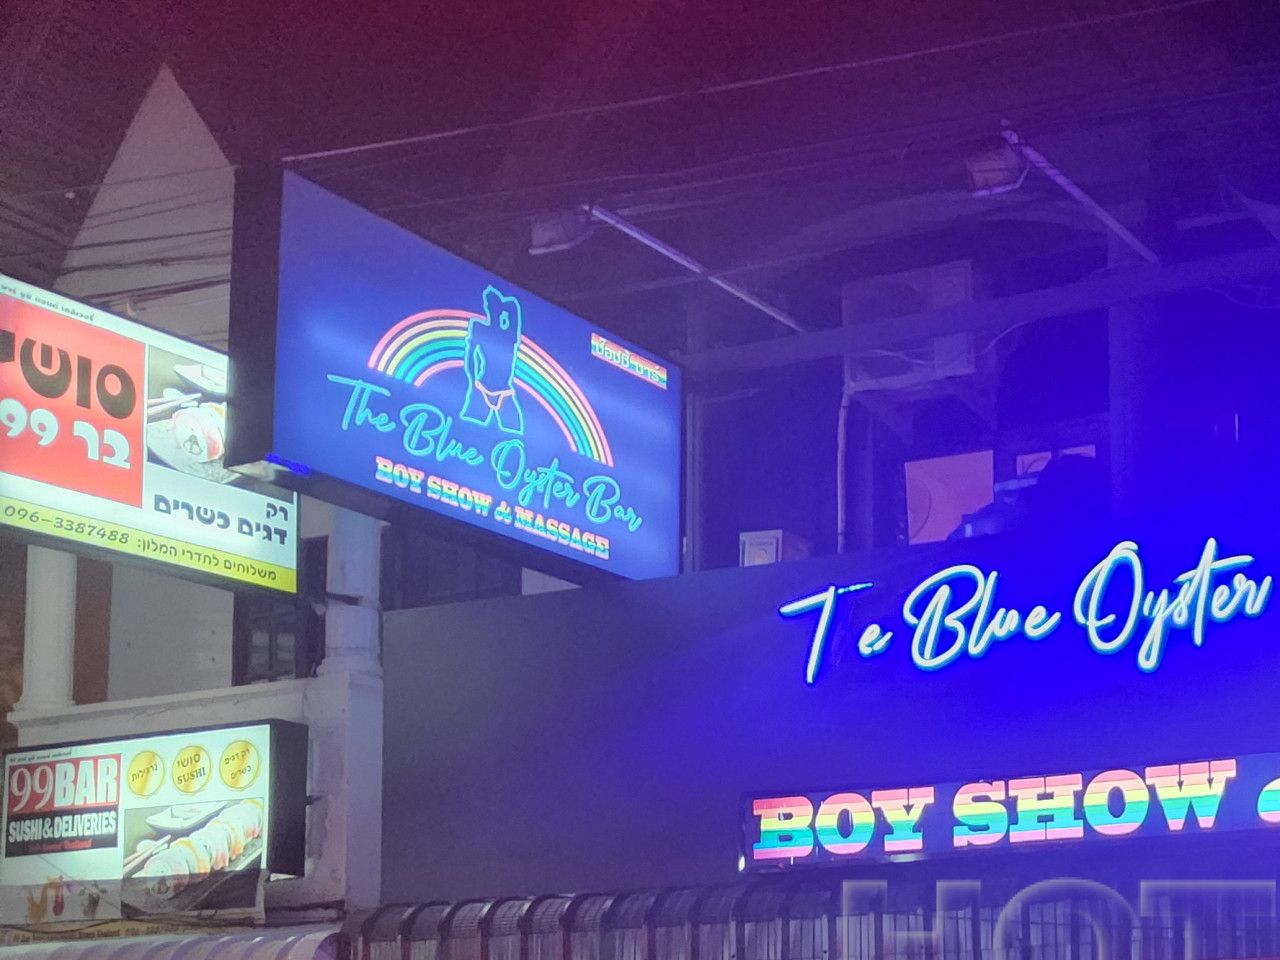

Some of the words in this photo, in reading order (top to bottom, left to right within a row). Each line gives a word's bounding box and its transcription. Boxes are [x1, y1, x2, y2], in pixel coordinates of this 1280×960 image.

[0, 399, 59, 446] 99
[73, 420, 131, 469] בר
[326, 374, 396, 431] The
[400, 403, 484, 466] Blue
[491, 439, 581, 509] Oyster
[583, 475, 643, 532] Bar
[4, 505, 130, 544] 096-3387488
[154, 495, 230, 530] כשרים
[266, 502, 289, 522] רק
[375, 456, 425, 494] BOY
[427, 475, 493, 518] SHOW
[495, 501, 512, 524] &
[514, 506, 610, 560] MASSAGE
[237, 516, 288, 545] דגים
[182, 547, 220, 567] לחדרי
[224, 560, 277, 581] משלוחים
[903, 563, 1062, 671] Blue
[1074, 537, 1272, 672] Oyster
[177, 753, 201, 768] סושי
[177, 767, 206, 785] SUSHI
[752, 787, 935, 861] BOY
[952, 759, 1237, 848] SHOW
